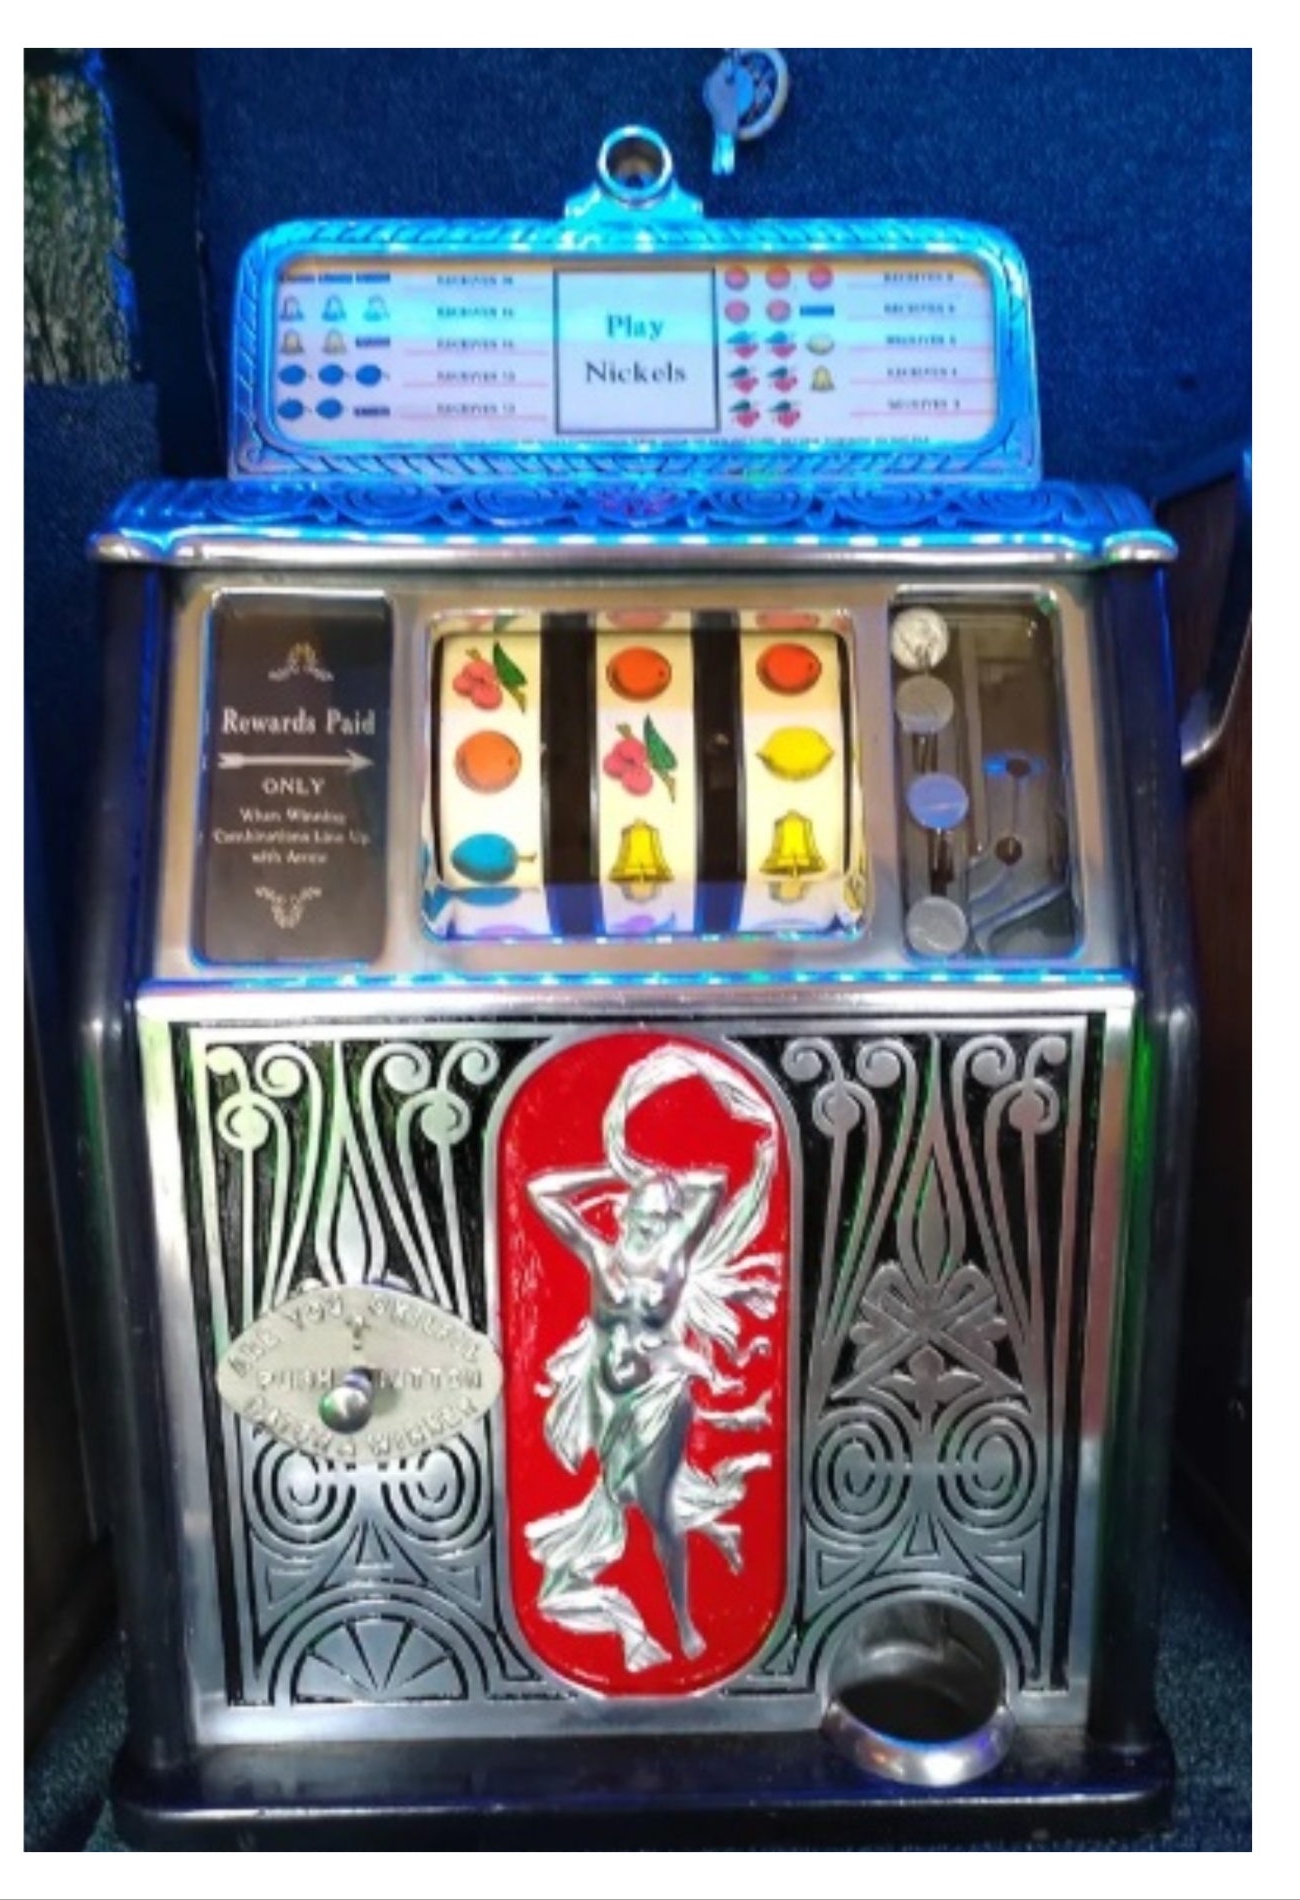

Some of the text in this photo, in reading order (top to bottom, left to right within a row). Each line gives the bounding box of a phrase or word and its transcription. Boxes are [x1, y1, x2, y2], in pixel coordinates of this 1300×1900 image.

[607, 314, 664, 341] Play
[585, 361, 687, 384] Nickels
[221, 706, 377, 735] Rewards Paid
[262, 777, 326, 796] ONLY
[240, 807, 347, 826] When Winning
[212, 828, 371, 847] Combinations Line Up
[252, 849, 328, 864] with Arrow
[282, 1294, 343, 1331] YOU
